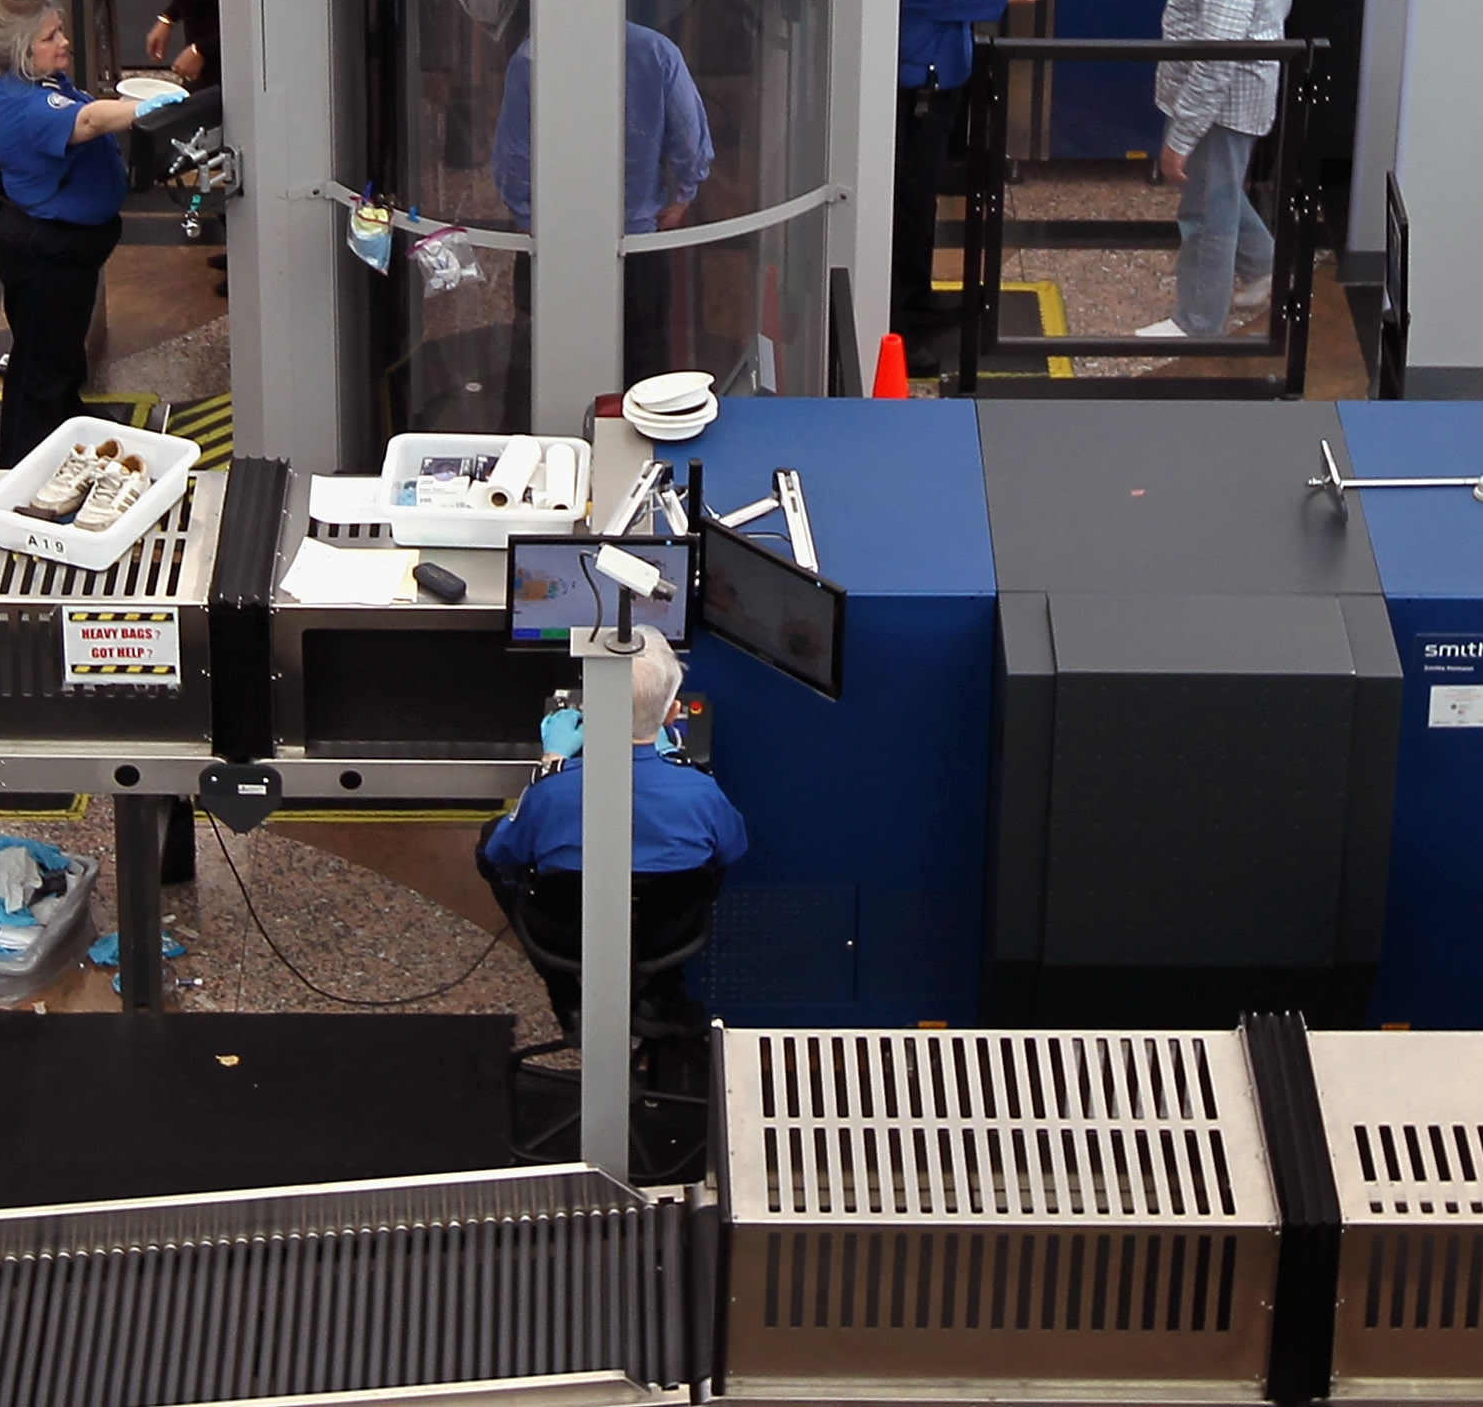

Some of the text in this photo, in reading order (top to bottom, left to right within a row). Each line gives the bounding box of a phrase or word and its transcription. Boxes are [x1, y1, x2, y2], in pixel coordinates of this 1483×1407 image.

[28, 534, 64, 553] A19
[81, 627, 117, 640] HEAVY
[91, 646, 114, 659] GOT
[117, 647, 145, 659] HELP
